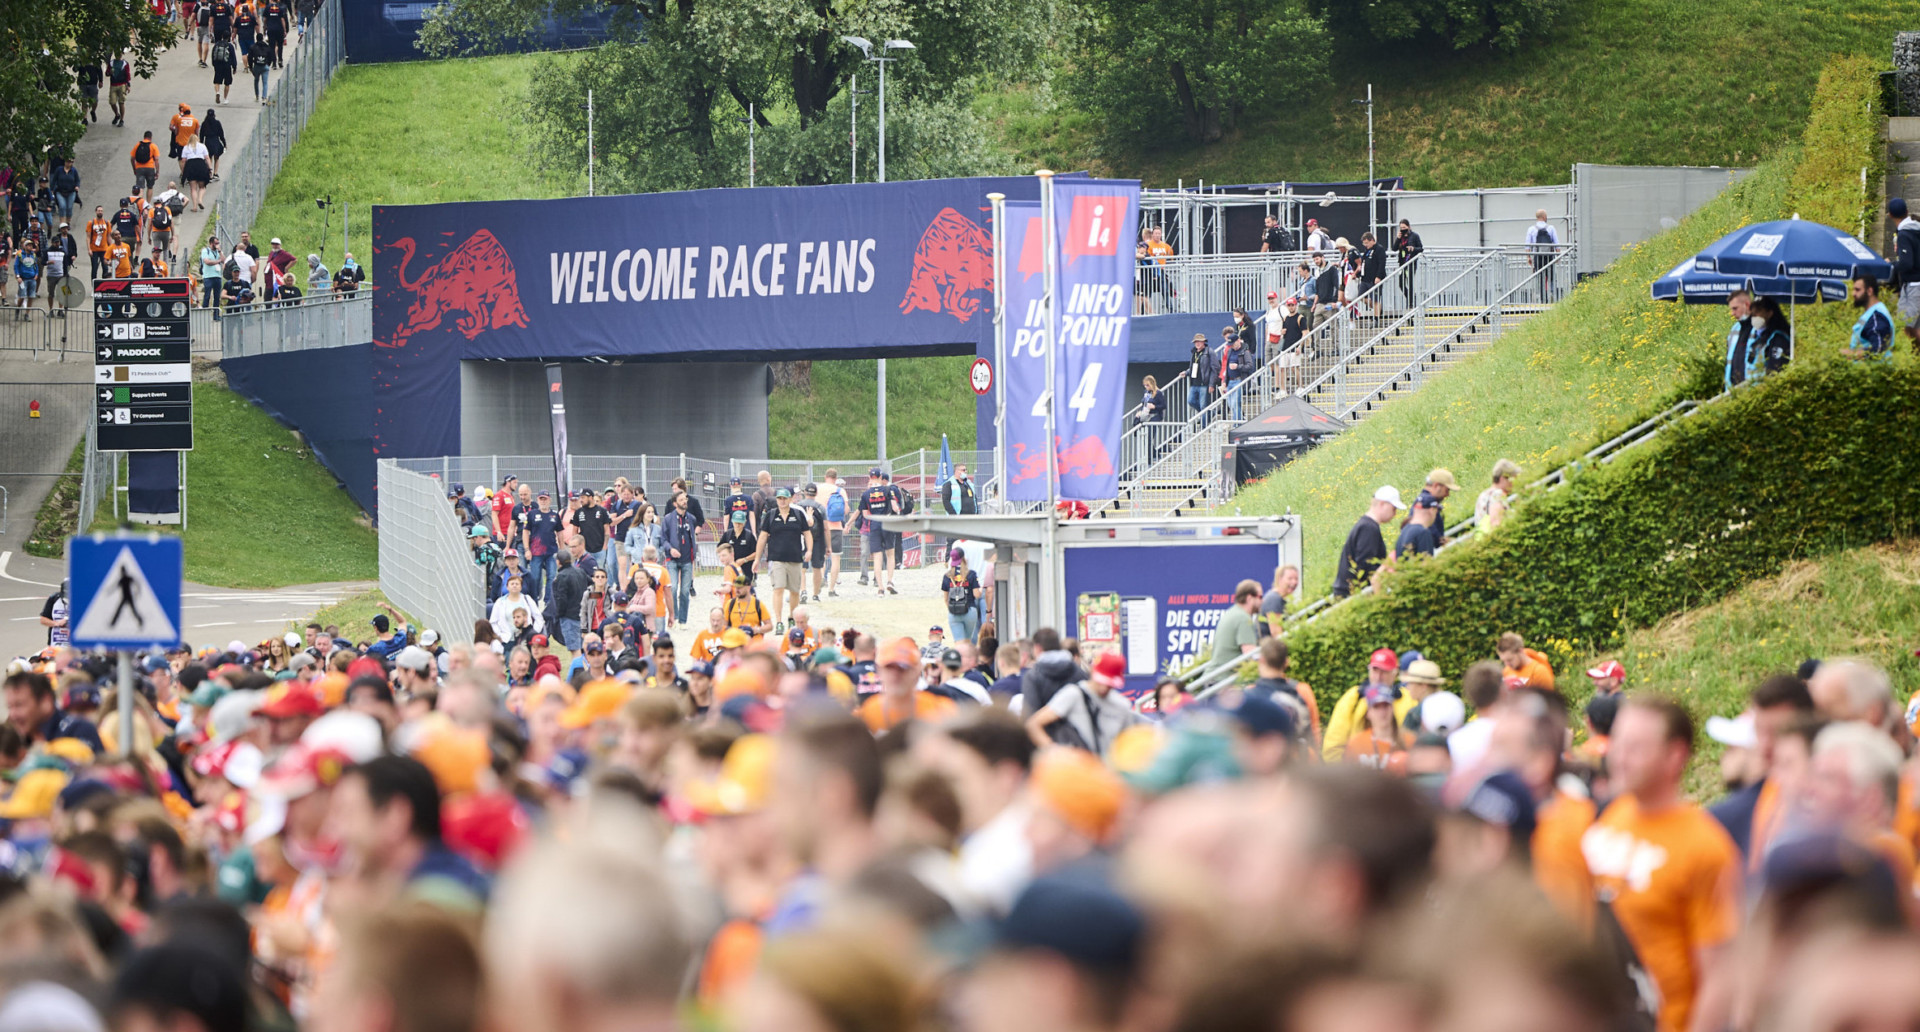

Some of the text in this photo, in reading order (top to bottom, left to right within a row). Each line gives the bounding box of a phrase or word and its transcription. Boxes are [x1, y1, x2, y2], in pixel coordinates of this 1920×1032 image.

[551, 238, 876, 304] WELCOME RACE FANS
[1788, 267, 1815, 275] WELCOME
[1067, 283, 1123, 315] INFO
[1058, 315, 1128, 347] POINT
[117, 348, 161, 356] PADDOCK
[1068, 362, 1103, 422] 4
[1167, 595, 1185, 604] ALLE
[1186, 595, 1210, 604] INFOS
[1211, 594, 1230, 604] ZUM
[1165, 609, 1191, 628] DIE
